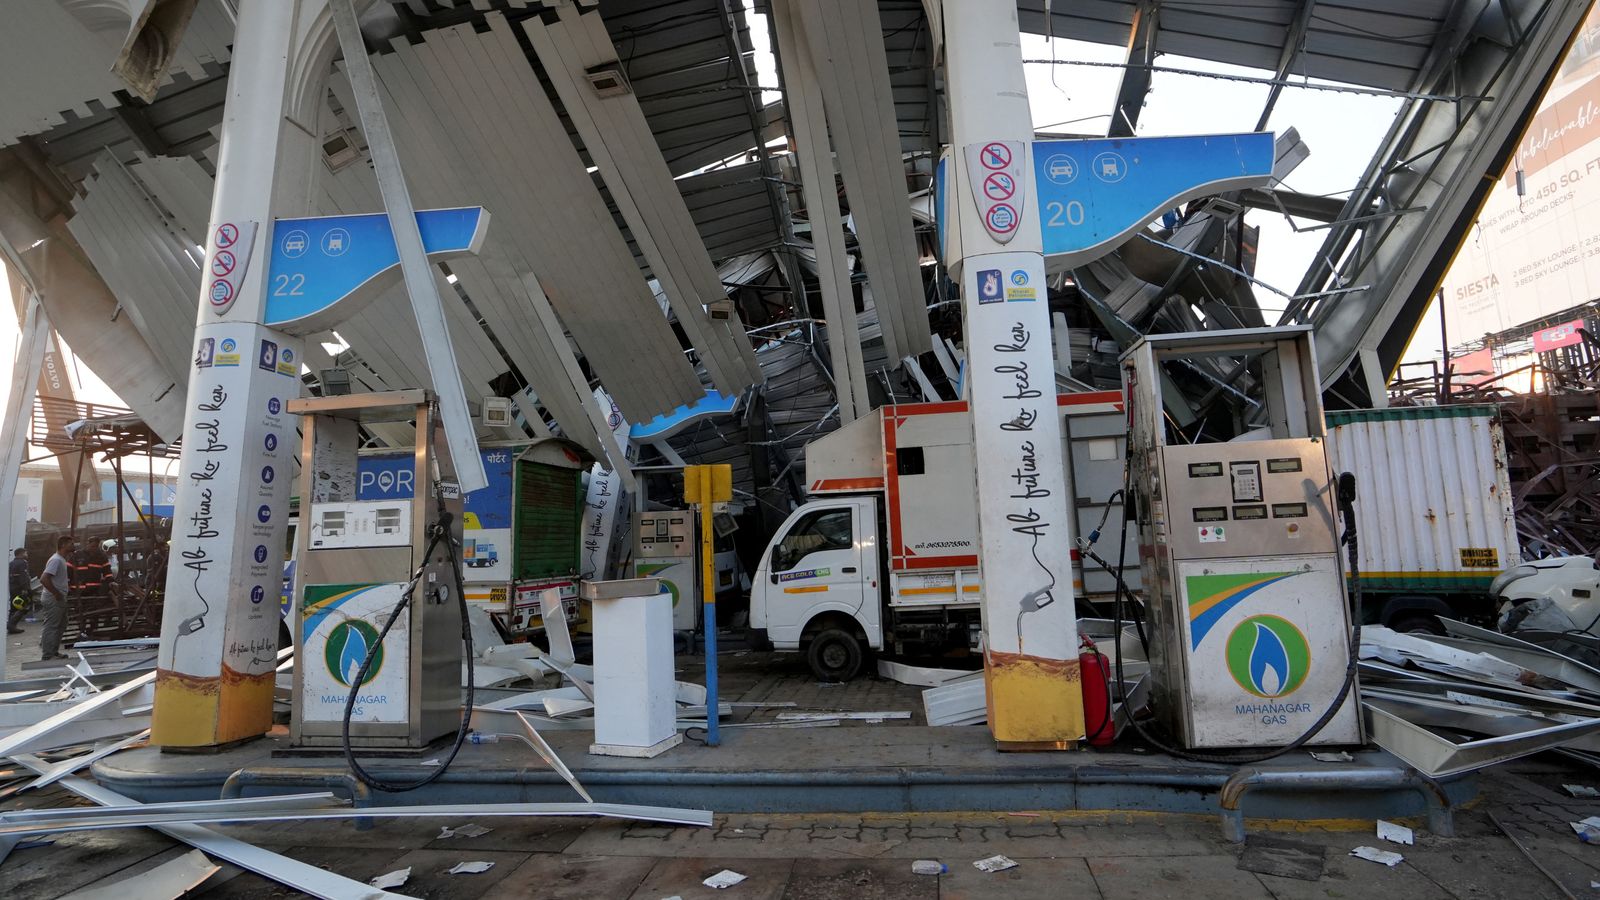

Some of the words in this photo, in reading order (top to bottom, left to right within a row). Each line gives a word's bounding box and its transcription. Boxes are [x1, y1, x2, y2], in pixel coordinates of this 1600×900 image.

[1498, 207, 1515, 221] WITH
[1536, 182, 1557, 199] 450
[1560, 169, 1583, 188] SQ.
[1047, 201, 1084, 227] 20
[1499, 219, 1519, 234] WRAP
[1520, 203, 1549, 225] AROUND
[1518, 264, 1532, 276] BED
[1532, 258, 1546, 269] SKY
[1547, 243, 1577, 263] LOUNGE
[1585, 234, 1600, 246] 2.8
[1520, 275, 1534, 286] BED
[1535, 269, 1548, 280] SKY
[1549, 255, 1578, 274] LOUNGE
[273, 274, 305, 297] 22
[1456, 272, 1500, 301] SIESTA
[44, 354, 61, 390] VOLVO
[994, 361, 1042, 400] feel
[1000, 408, 1037, 431] ko
[195, 419, 228, 452] feel
[190, 460, 220, 481] ko
[487, 452, 507, 463] पोर्टर
[1010, 441, 1050, 499] future
[186, 488, 219, 539] future
[1006, 508, 1050, 536] Ab
[181, 546, 213, 571] Ab
[795, 570, 813, 578] GOLD
[1235, 703, 1311, 714] MAHANAGAR
[1262, 715, 1287, 725] GAS
